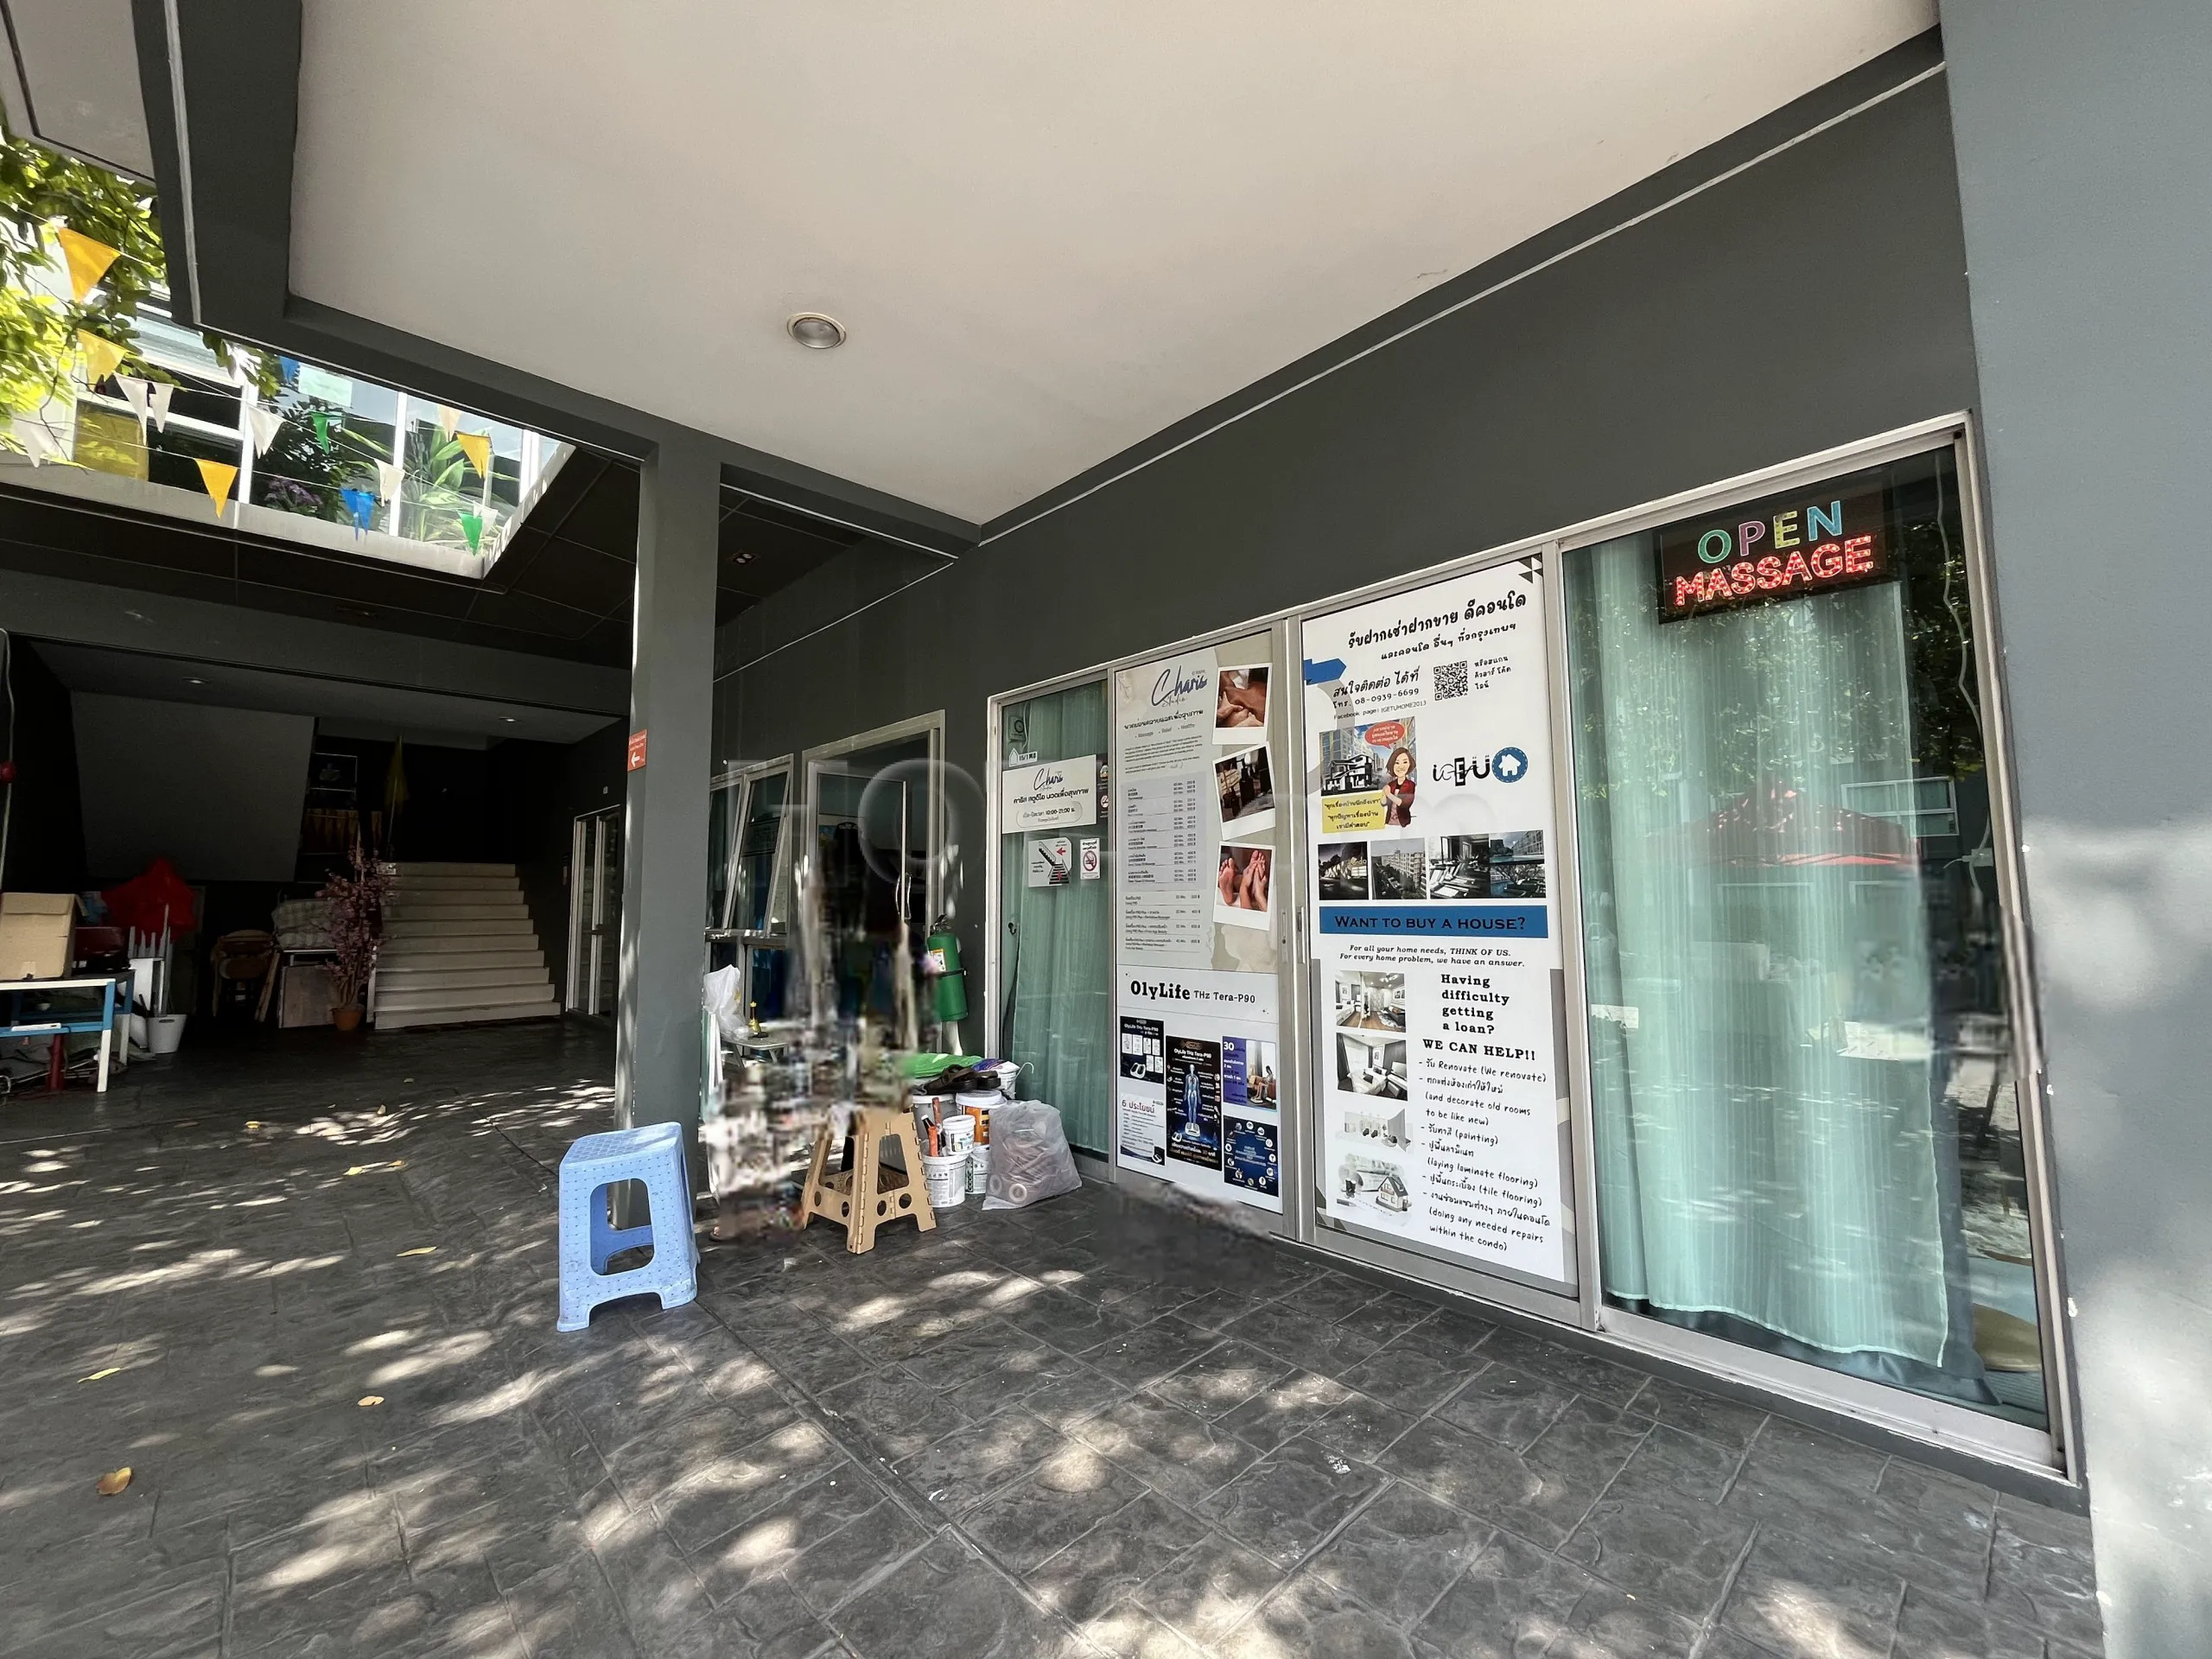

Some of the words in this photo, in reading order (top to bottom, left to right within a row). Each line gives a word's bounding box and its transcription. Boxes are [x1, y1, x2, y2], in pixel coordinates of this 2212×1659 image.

[1698, 500, 1842, 563] OPEN
[1675, 536, 1873, 606] MASSAGE
[1349, 611, 1459, 648] รับฝากเช่าฝากขาย
[1465, 590, 1526, 620] ดีคอนโด
[1151, 665, 1208, 706] Charis
[1333, 676, 1390, 697] สนใจติดต่อ
[1395, 665, 1420, 684] ได้ที่
[1355, 688, 1419, 705] 08-0939-6699
[1333, 711, 1360, 720] Facebook
[1335, 916, 1377, 928] WANT
[1382, 918, 1401, 928] TO
[1407, 918, 1436, 929] BUY
[1441, 918, 1452, 929] A
[1459, 917, 1525, 930] HOUSE?
[1130, 980, 1191, 1000] OlyLife
[1193, 990, 1210, 999] THz
[1213, 992, 1255, 1003] Tera-P90
[1441, 974, 1491, 988] Having
[1441, 989, 1510, 1006] difficulty
[1442, 1007, 1494, 1021] getting
[1455, 1021, 1495, 1034] loan?
[1224, 1041, 1235, 1052] 30
[1422, 1039, 1444, 1050] WE
[1449, 1042, 1478, 1054] CAN
[1484, 1046, 1535, 1060] HELP!!
[1427, 1058, 1435, 1068] รับ
[1439, 1061, 1477, 1073] Renovate
[1480, 1065, 1497, 1076] (We
[1500, 1071, 1547, 1083] renovate)
[1425, 1091, 1443, 1102] (and
[1446, 1095, 1484, 1108] decorate
[1488, 1102, 1501, 1111] old
[1504, 1106, 1531, 1116] rooms
[1426, 1109, 1434, 1117] to
[1438, 1110, 1447, 1119] be
[1451, 1112, 1465, 1122] like
[1468, 1117, 1489, 1126] new)
[1455, 1129, 1498, 1147] (painting)
[1427, 1157, 1453, 1173] (laying
[1457, 1163, 1495, 1179] laminate
[1498, 1172, 1538, 1189] flooring)
[1479, 1185, 1498, 1197] (tile
[1503, 1190, 1542, 1208] flooring)
[1429, 1207, 1455, 1223] (doing
[1458, 1216, 1472, 1227] any
[1476, 1221, 1508, 1234] needed
[1511, 1230, 1543, 1243] repairs
[1430, 1225, 1456, 1237] within
[1459, 1230, 1475, 1243] the
[1478, 1236, 1508, 1251] condo)
